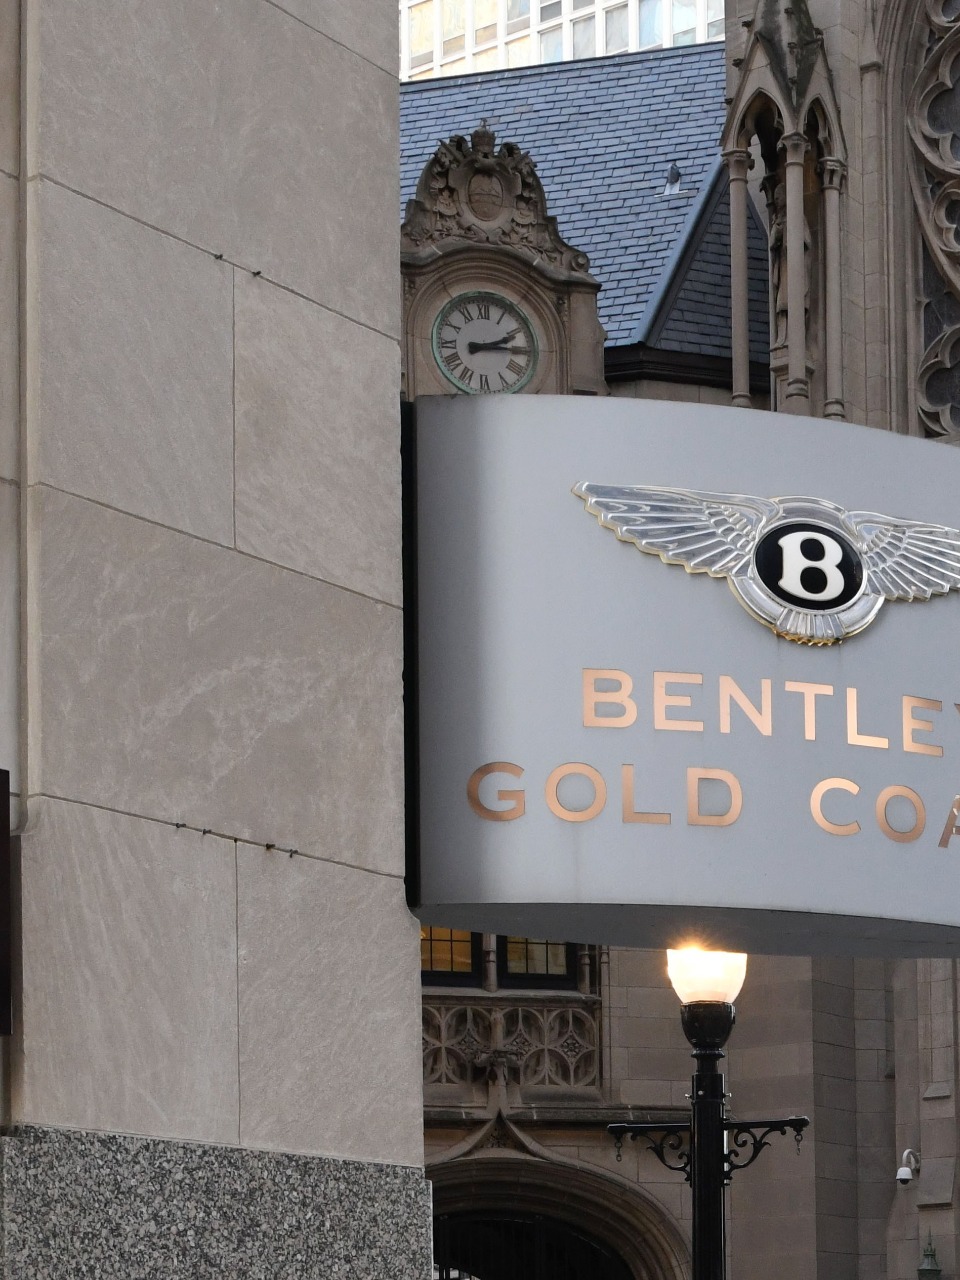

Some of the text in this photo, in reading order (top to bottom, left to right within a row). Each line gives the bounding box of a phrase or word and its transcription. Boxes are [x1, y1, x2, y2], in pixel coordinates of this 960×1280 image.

[477, 304, 490, 320] XII
[777, 530, 845, 601] B
[466, 761, 744, 828] GOLD
